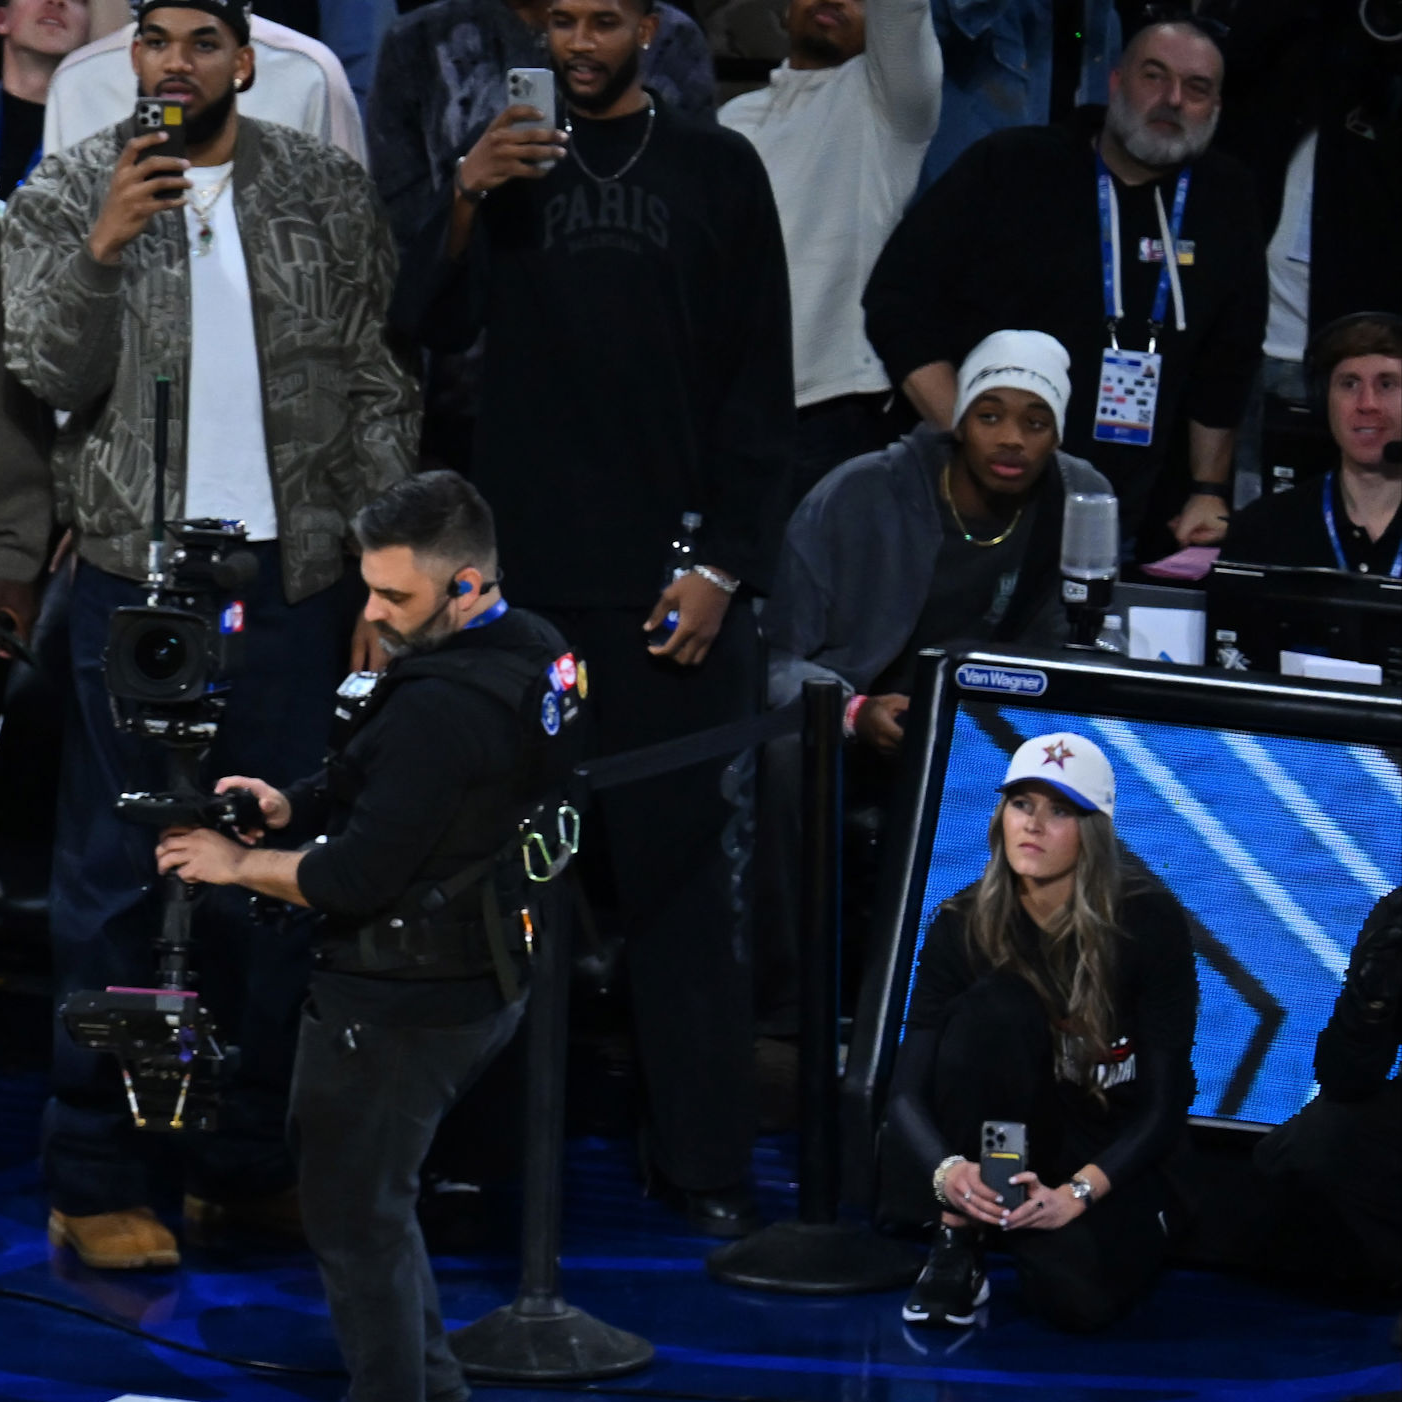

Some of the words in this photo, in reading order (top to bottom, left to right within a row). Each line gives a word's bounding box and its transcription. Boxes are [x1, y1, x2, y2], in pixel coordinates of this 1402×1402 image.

[543, 181, 671, 250] PARIS
[962, 668, 988, 685] Van
[990, 671, 1041, 692] Wagner
